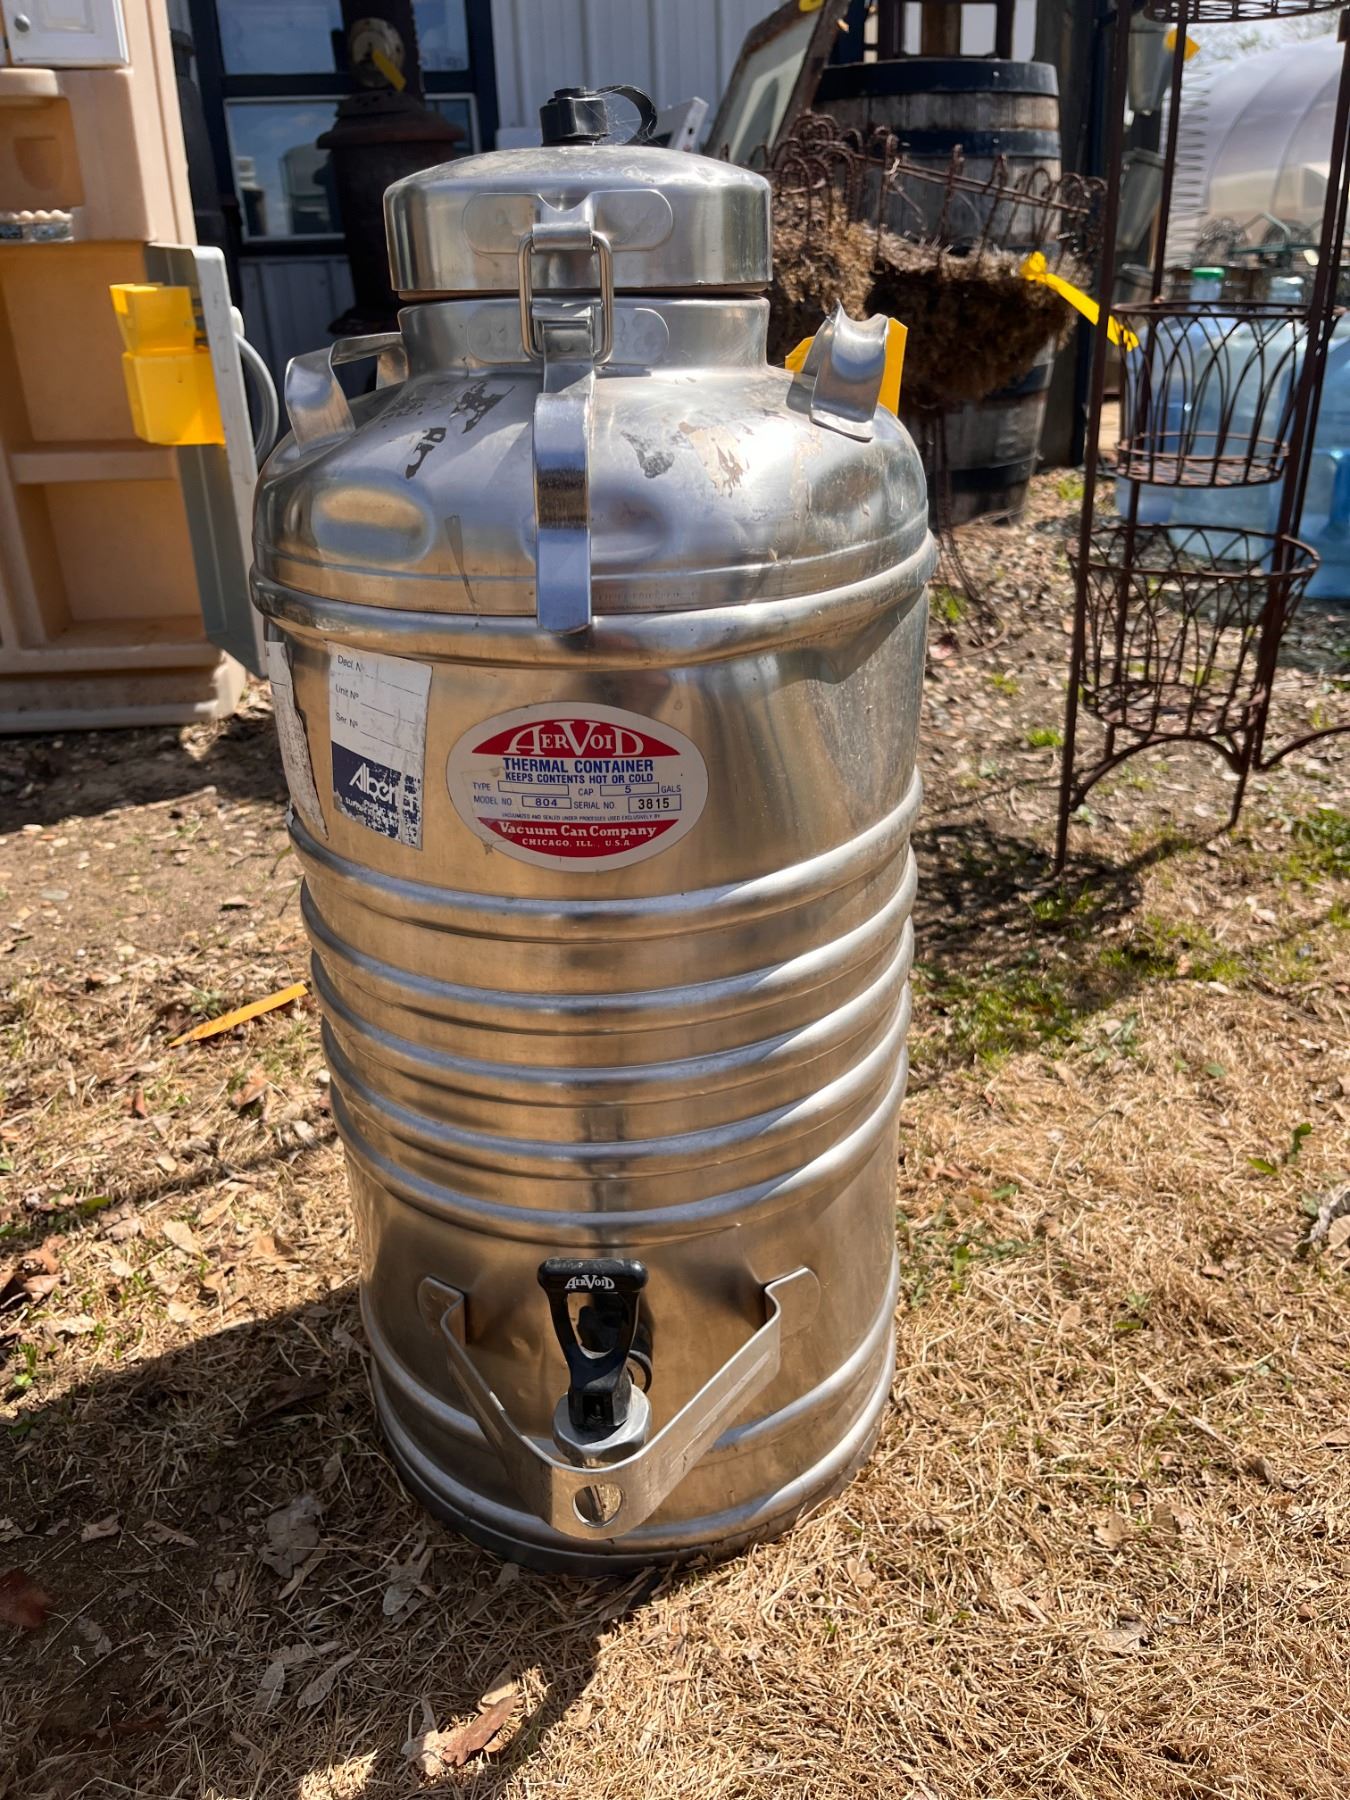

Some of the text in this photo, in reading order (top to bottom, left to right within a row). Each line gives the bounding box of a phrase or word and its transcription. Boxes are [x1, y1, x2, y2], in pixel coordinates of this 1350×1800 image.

[503, 757, 654, 773] THERMAL CONTAINER
[505, 772, 653, 784] KEEPS CONTENTS HOT OR COLD
[473, 782, 682, 796] TYPE CAP 5 GALS
[473, 795, 498, 805] MODEL
[535, 798, 557, 807] 804
[573, 801, 600, 809] SERIAL
[638, 798, 670, 810] 3815
[498, 821, 657, 838] Vacuum Can Company
